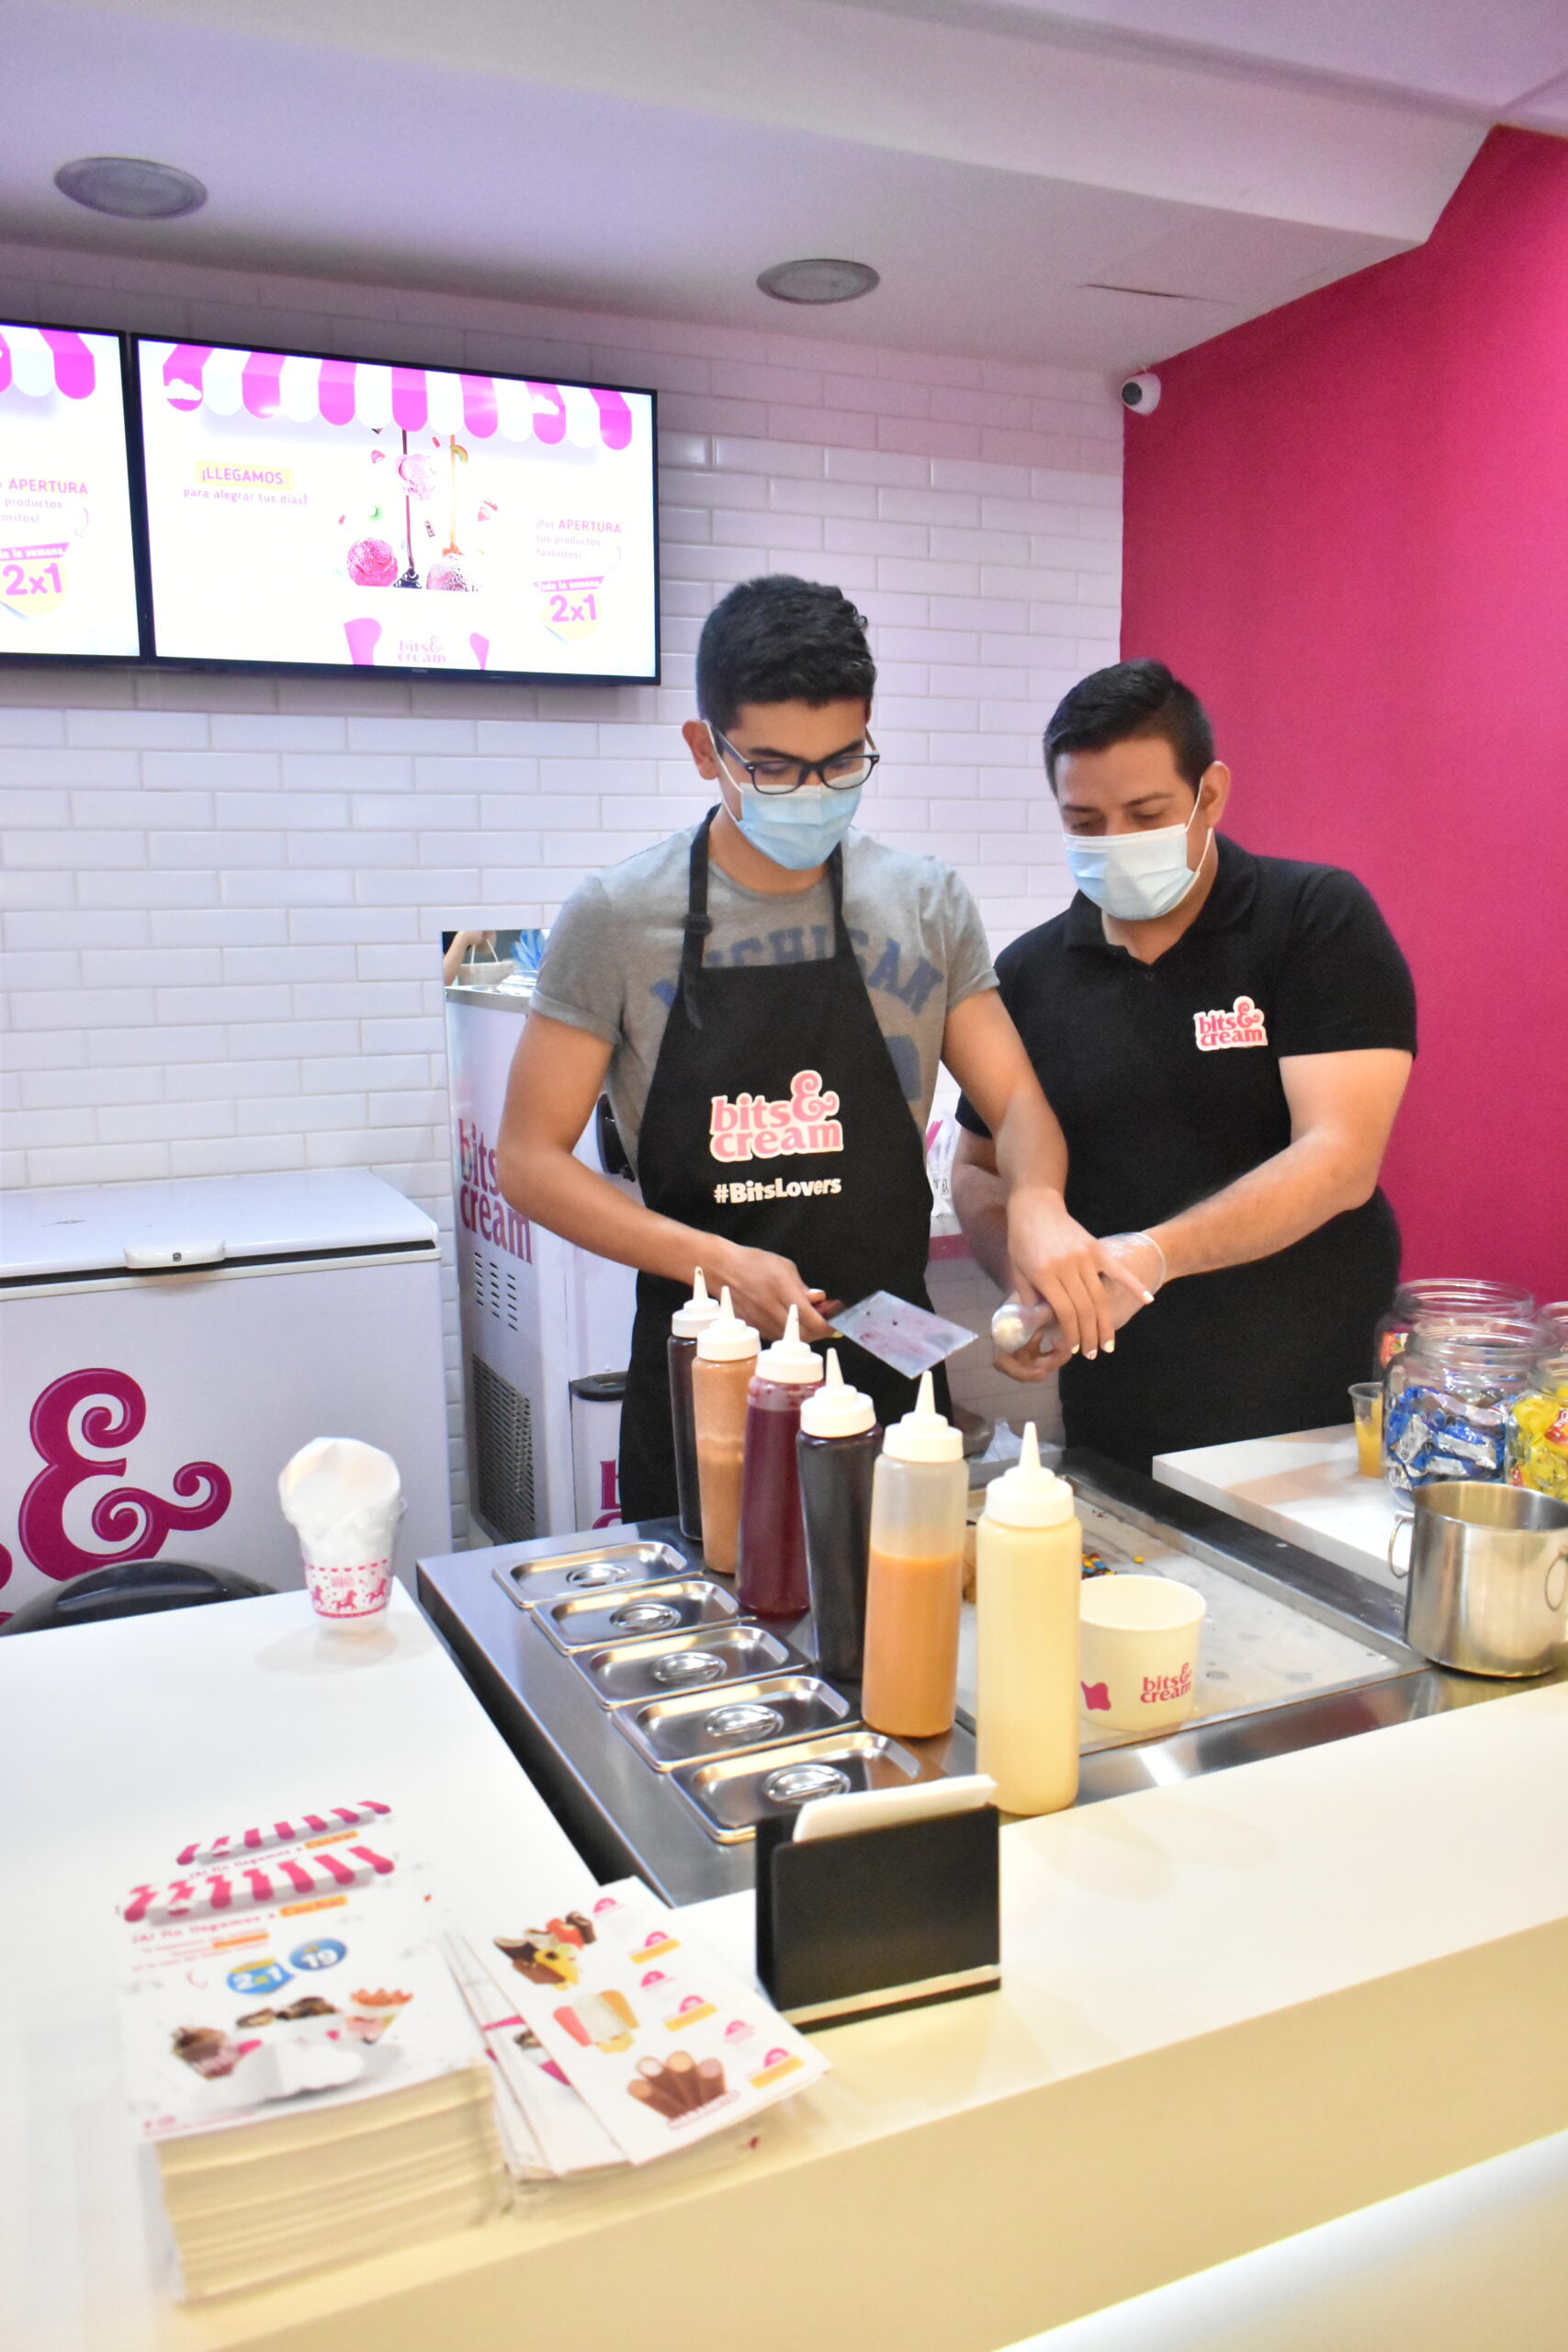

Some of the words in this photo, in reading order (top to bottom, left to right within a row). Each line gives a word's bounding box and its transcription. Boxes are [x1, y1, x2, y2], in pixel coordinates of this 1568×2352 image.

[201, 466, 284, 485] ¡LLEGAMOS
[8, 478, 89, 494] APERTURA
[183, 488, 209, 499] para
[213, 489, 254, 503] alegrar
[258, 492, 276, 503] tus
[5, 497, 63, 509] productos
[0, 513, 40, 523] oritos!
[558, 518, 622, 534] APERTURA
[554, 536, 601, 547] productos
[2, 561, 62, 595] 2x1
[549, 593, 598, 623] 2x1
[1200, 1028, 1263, 1047] cream
[713, 1122, 842, 1159] cream
[458, 1118, 501, 1197] bits
[713, 1177, 842, 1204] #BitsLovers
[459, 1183, 534, 1266] cream
[1139, 1680, 1191, 1703] cream
